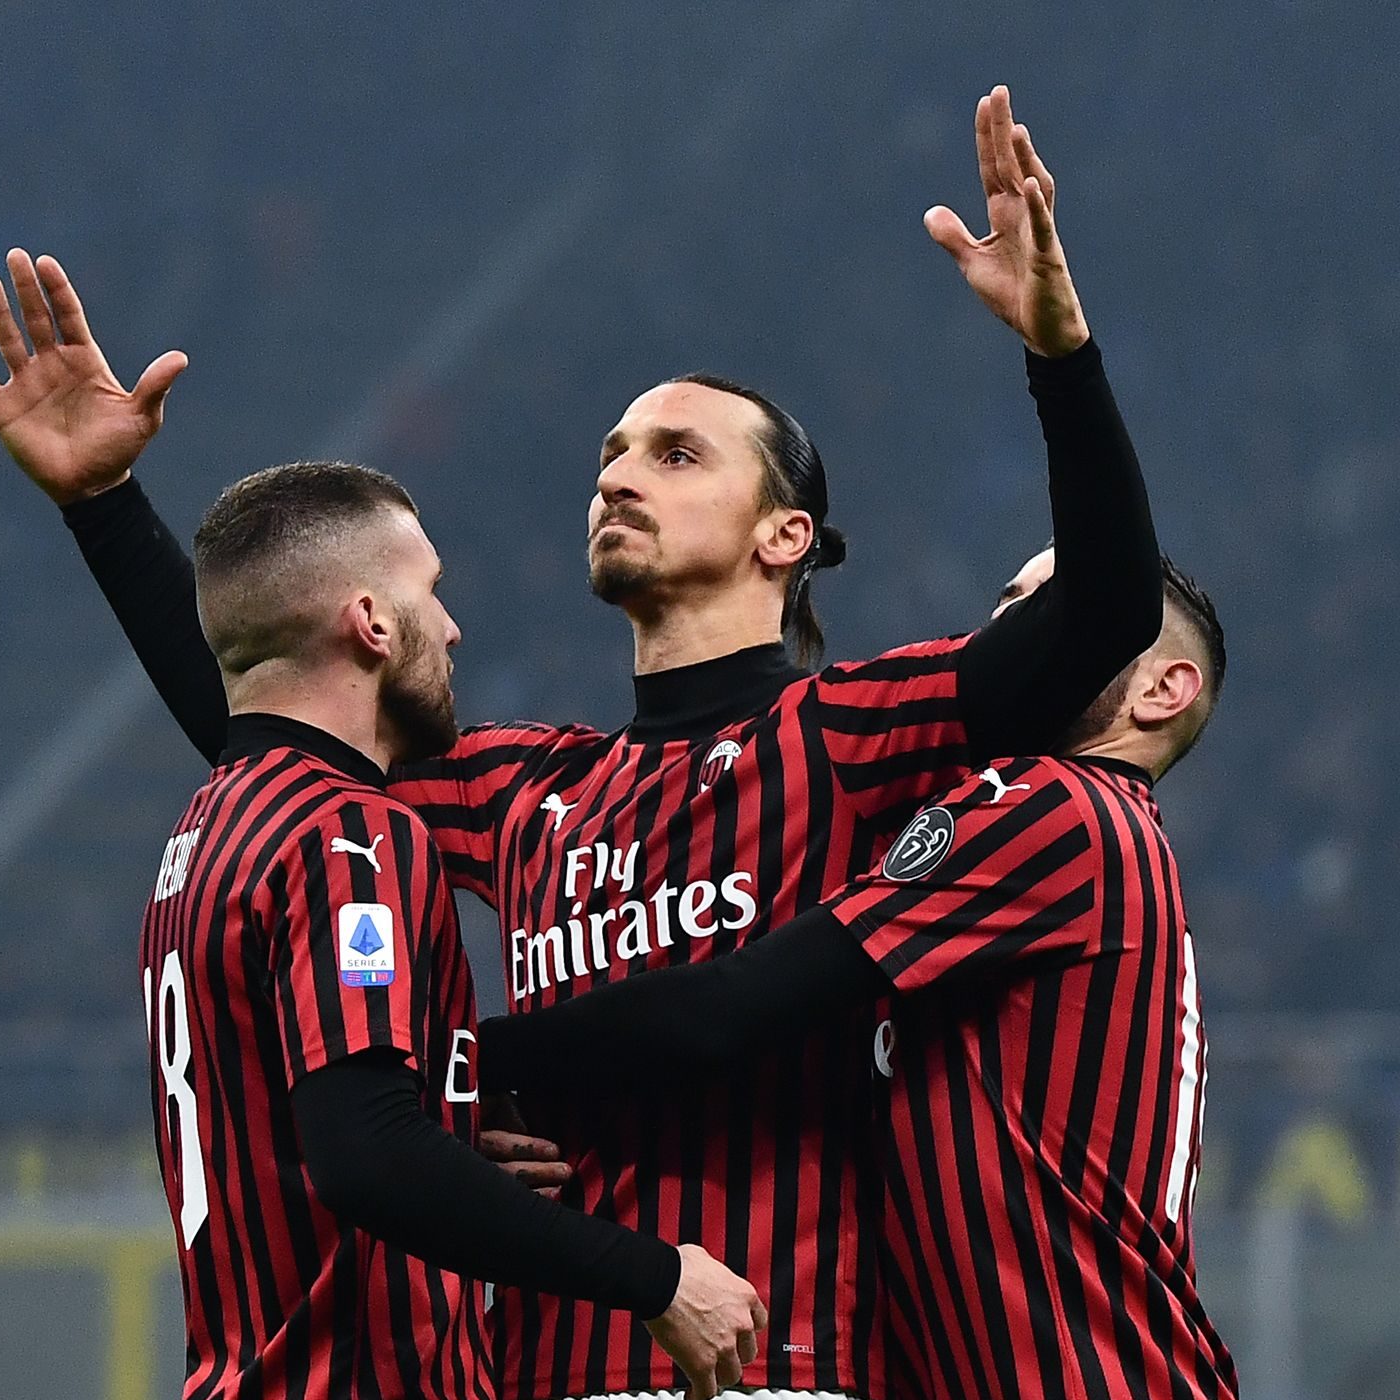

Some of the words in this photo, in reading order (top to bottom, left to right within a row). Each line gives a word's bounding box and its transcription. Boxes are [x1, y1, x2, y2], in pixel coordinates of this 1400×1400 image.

[901, 840, 922, 859] 7
[564, 840, 641, 898] Fly
[511, 871, 757, 1002] Emirates
[347, 959, 377, 967] SERIE
[380, 959, 387, 967] A
[782, 1344, 816, 1354] DRYCELL
